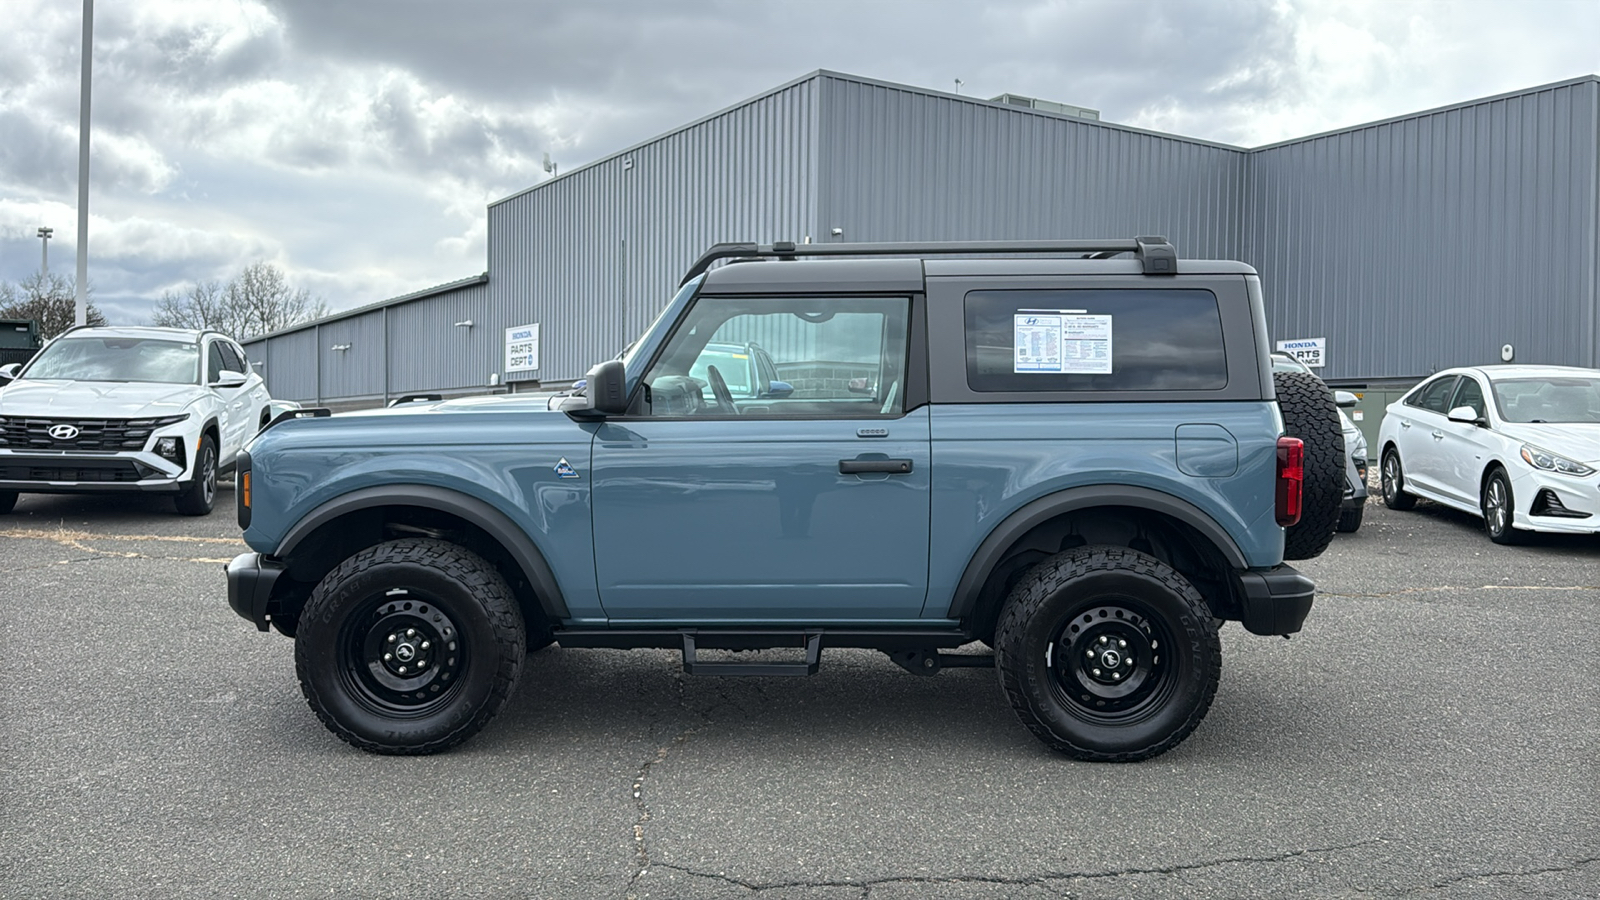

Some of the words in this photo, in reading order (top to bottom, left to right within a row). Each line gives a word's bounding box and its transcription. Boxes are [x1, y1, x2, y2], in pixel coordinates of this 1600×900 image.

[512, 331, 532, 339] HONDA
[511, 343, 532, 354] PARTS
[511, 356, 527, 366] DEPT
